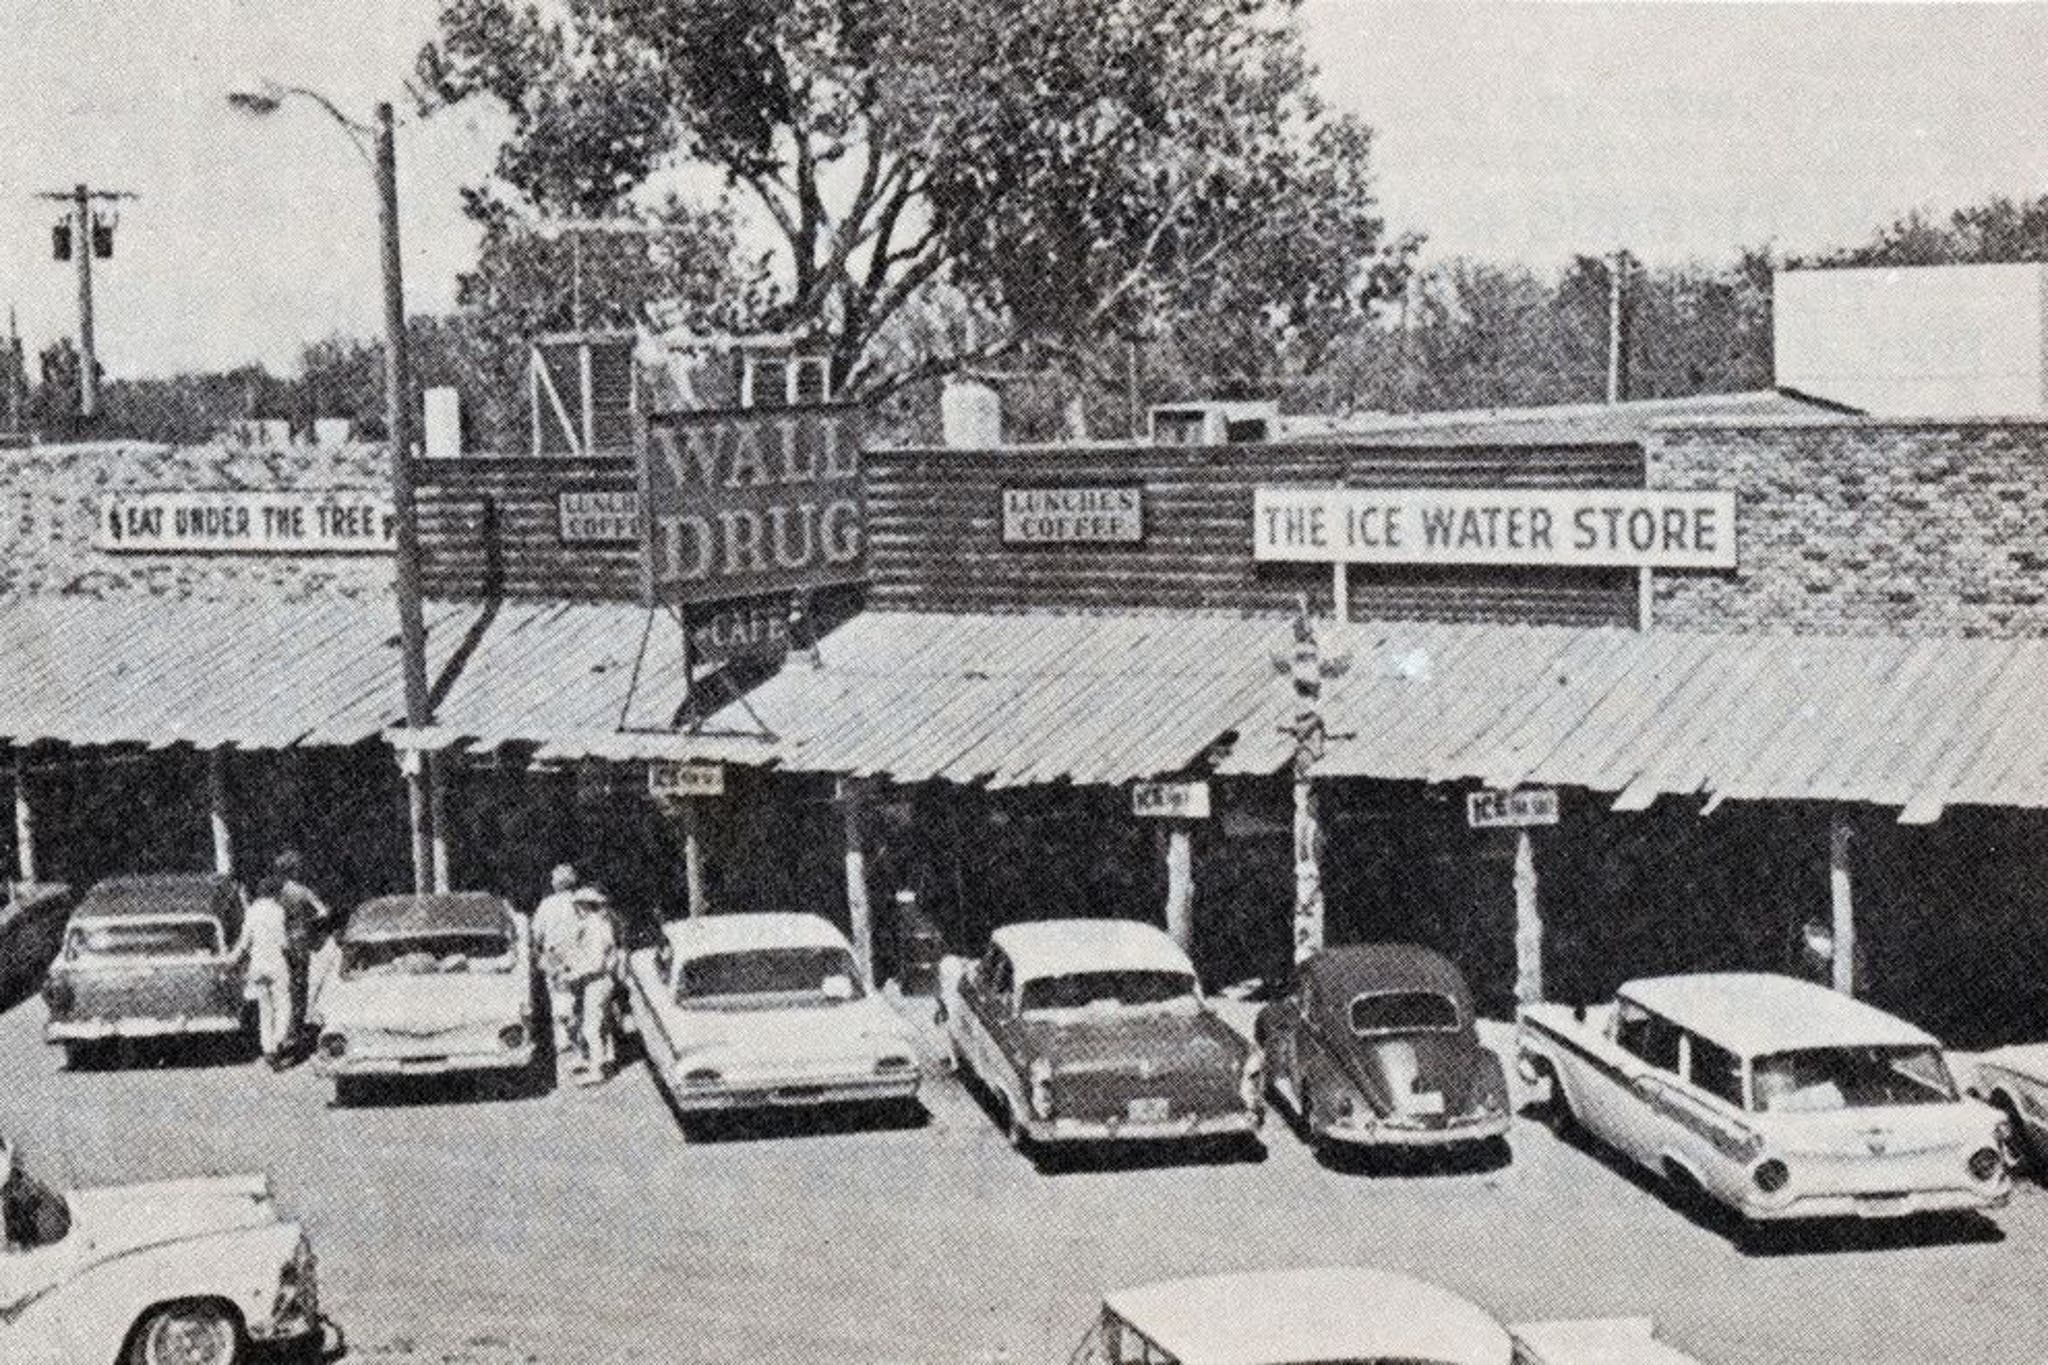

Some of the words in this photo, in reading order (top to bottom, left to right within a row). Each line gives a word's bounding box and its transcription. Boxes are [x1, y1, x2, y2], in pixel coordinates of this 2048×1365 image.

[565, 496, 638, 513] LUNCH
[1010, 492, 1133, 513] LUNCHES
[127, 505, 163, 537] EAT
[175, 505, 250, 538] UNDER
[262, 505, 304, 538] THE
[316, 504, 375, 538] TREE
[568, 518, 638, 536] COFF
[1264, 506, 1328, 547] THE
[1346, 506, 1401, 547] ICE
[1421, 506, 1553, 549] WATER
[1573, 506, 1717, 551] STORE
[658, 500, 862, 584] DRUG
